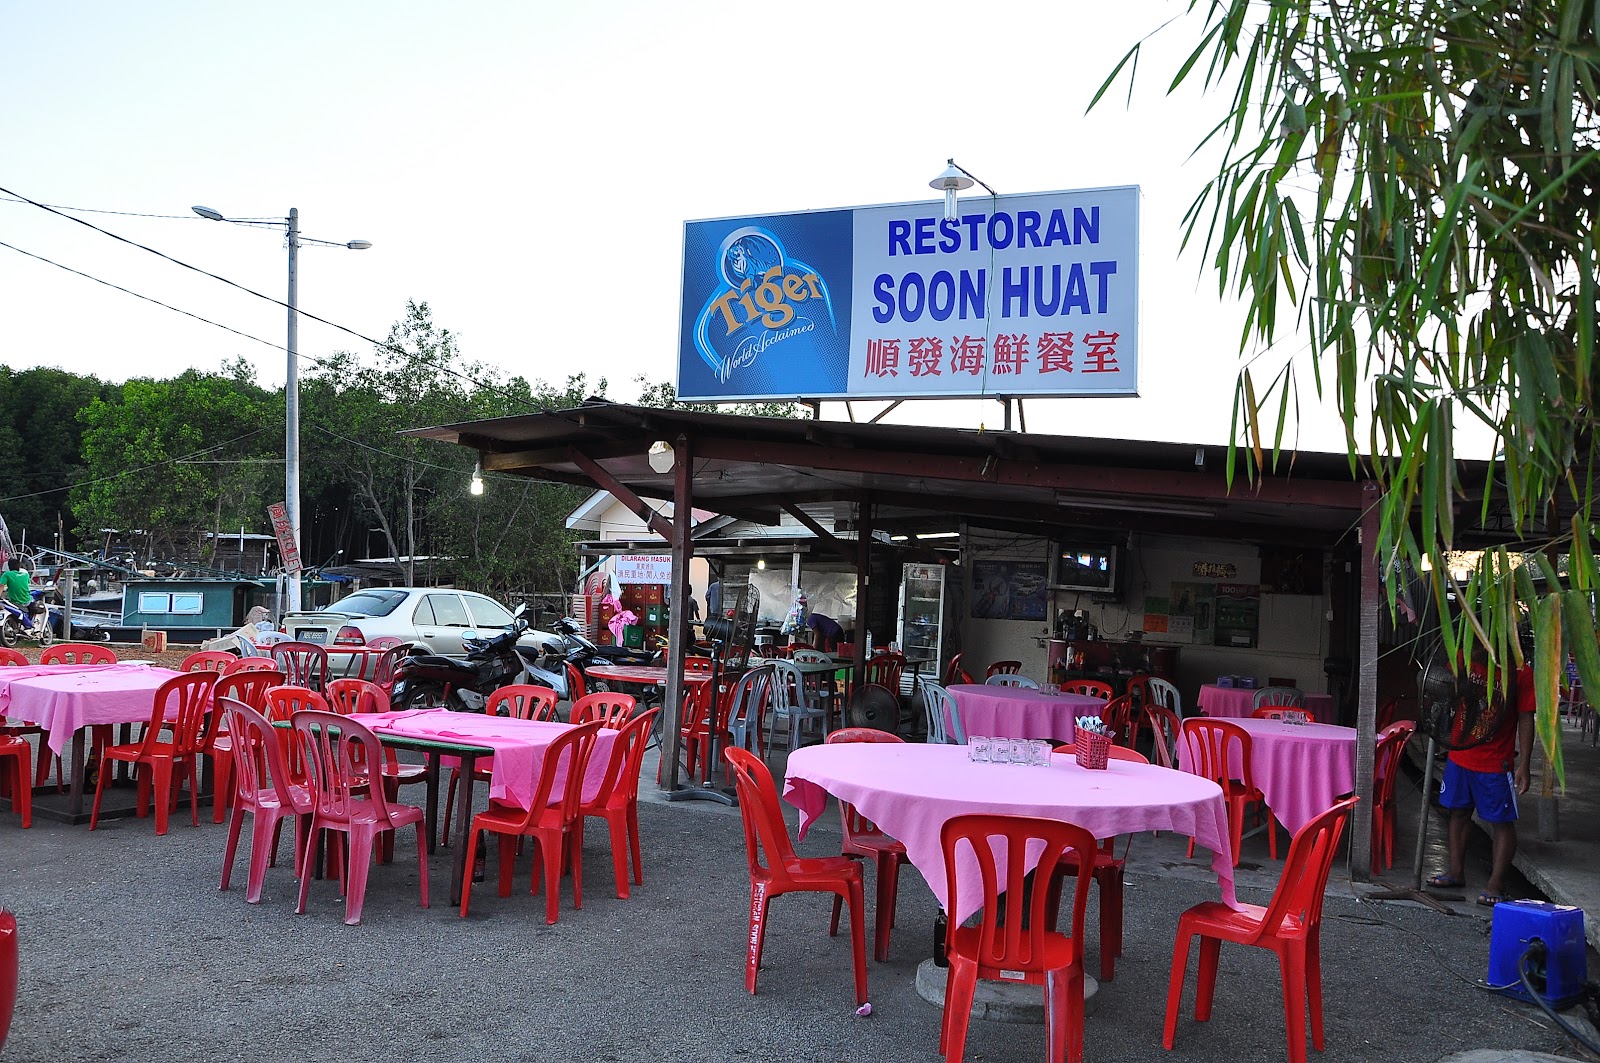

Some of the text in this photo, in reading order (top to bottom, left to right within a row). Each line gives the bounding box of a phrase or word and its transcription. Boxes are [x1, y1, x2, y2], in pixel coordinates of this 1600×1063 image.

[888, 206, 1100, 256] RESTORAN
[710, 264, 824, 336] Tiger
[872, 260, 1118, 324] SOON HUAT
[715, 316, 815, 384] World Acclaimed
[863, 330, 1121, 378] 順發海鮮餐室
